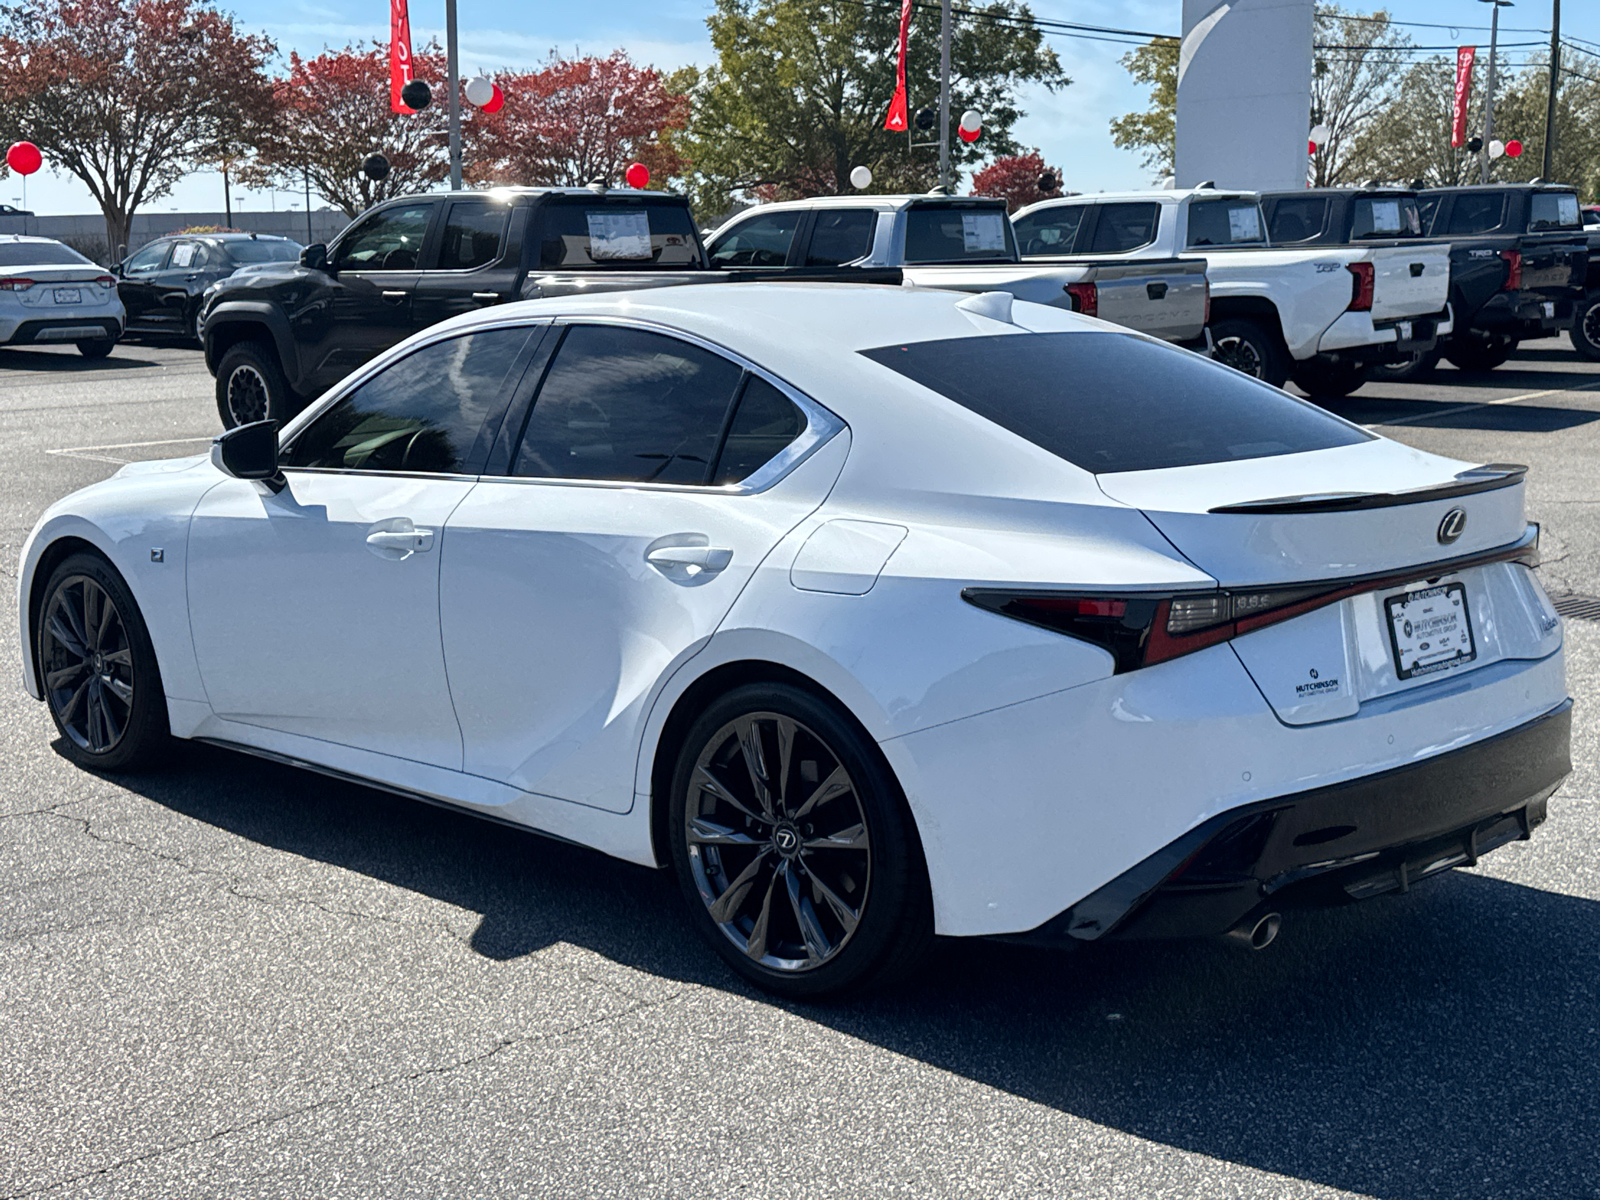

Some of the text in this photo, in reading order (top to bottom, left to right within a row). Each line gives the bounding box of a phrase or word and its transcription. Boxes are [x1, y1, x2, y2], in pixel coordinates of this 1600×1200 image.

[1468, 249, 1493, 257] TRD
[1414, 613, 1457, 633] HUTCHINSON
[1416, 624, 1457, 640] AUTOMOTIVE GROUP
[1296, 679, 1339, 693] HUTCHINSON
